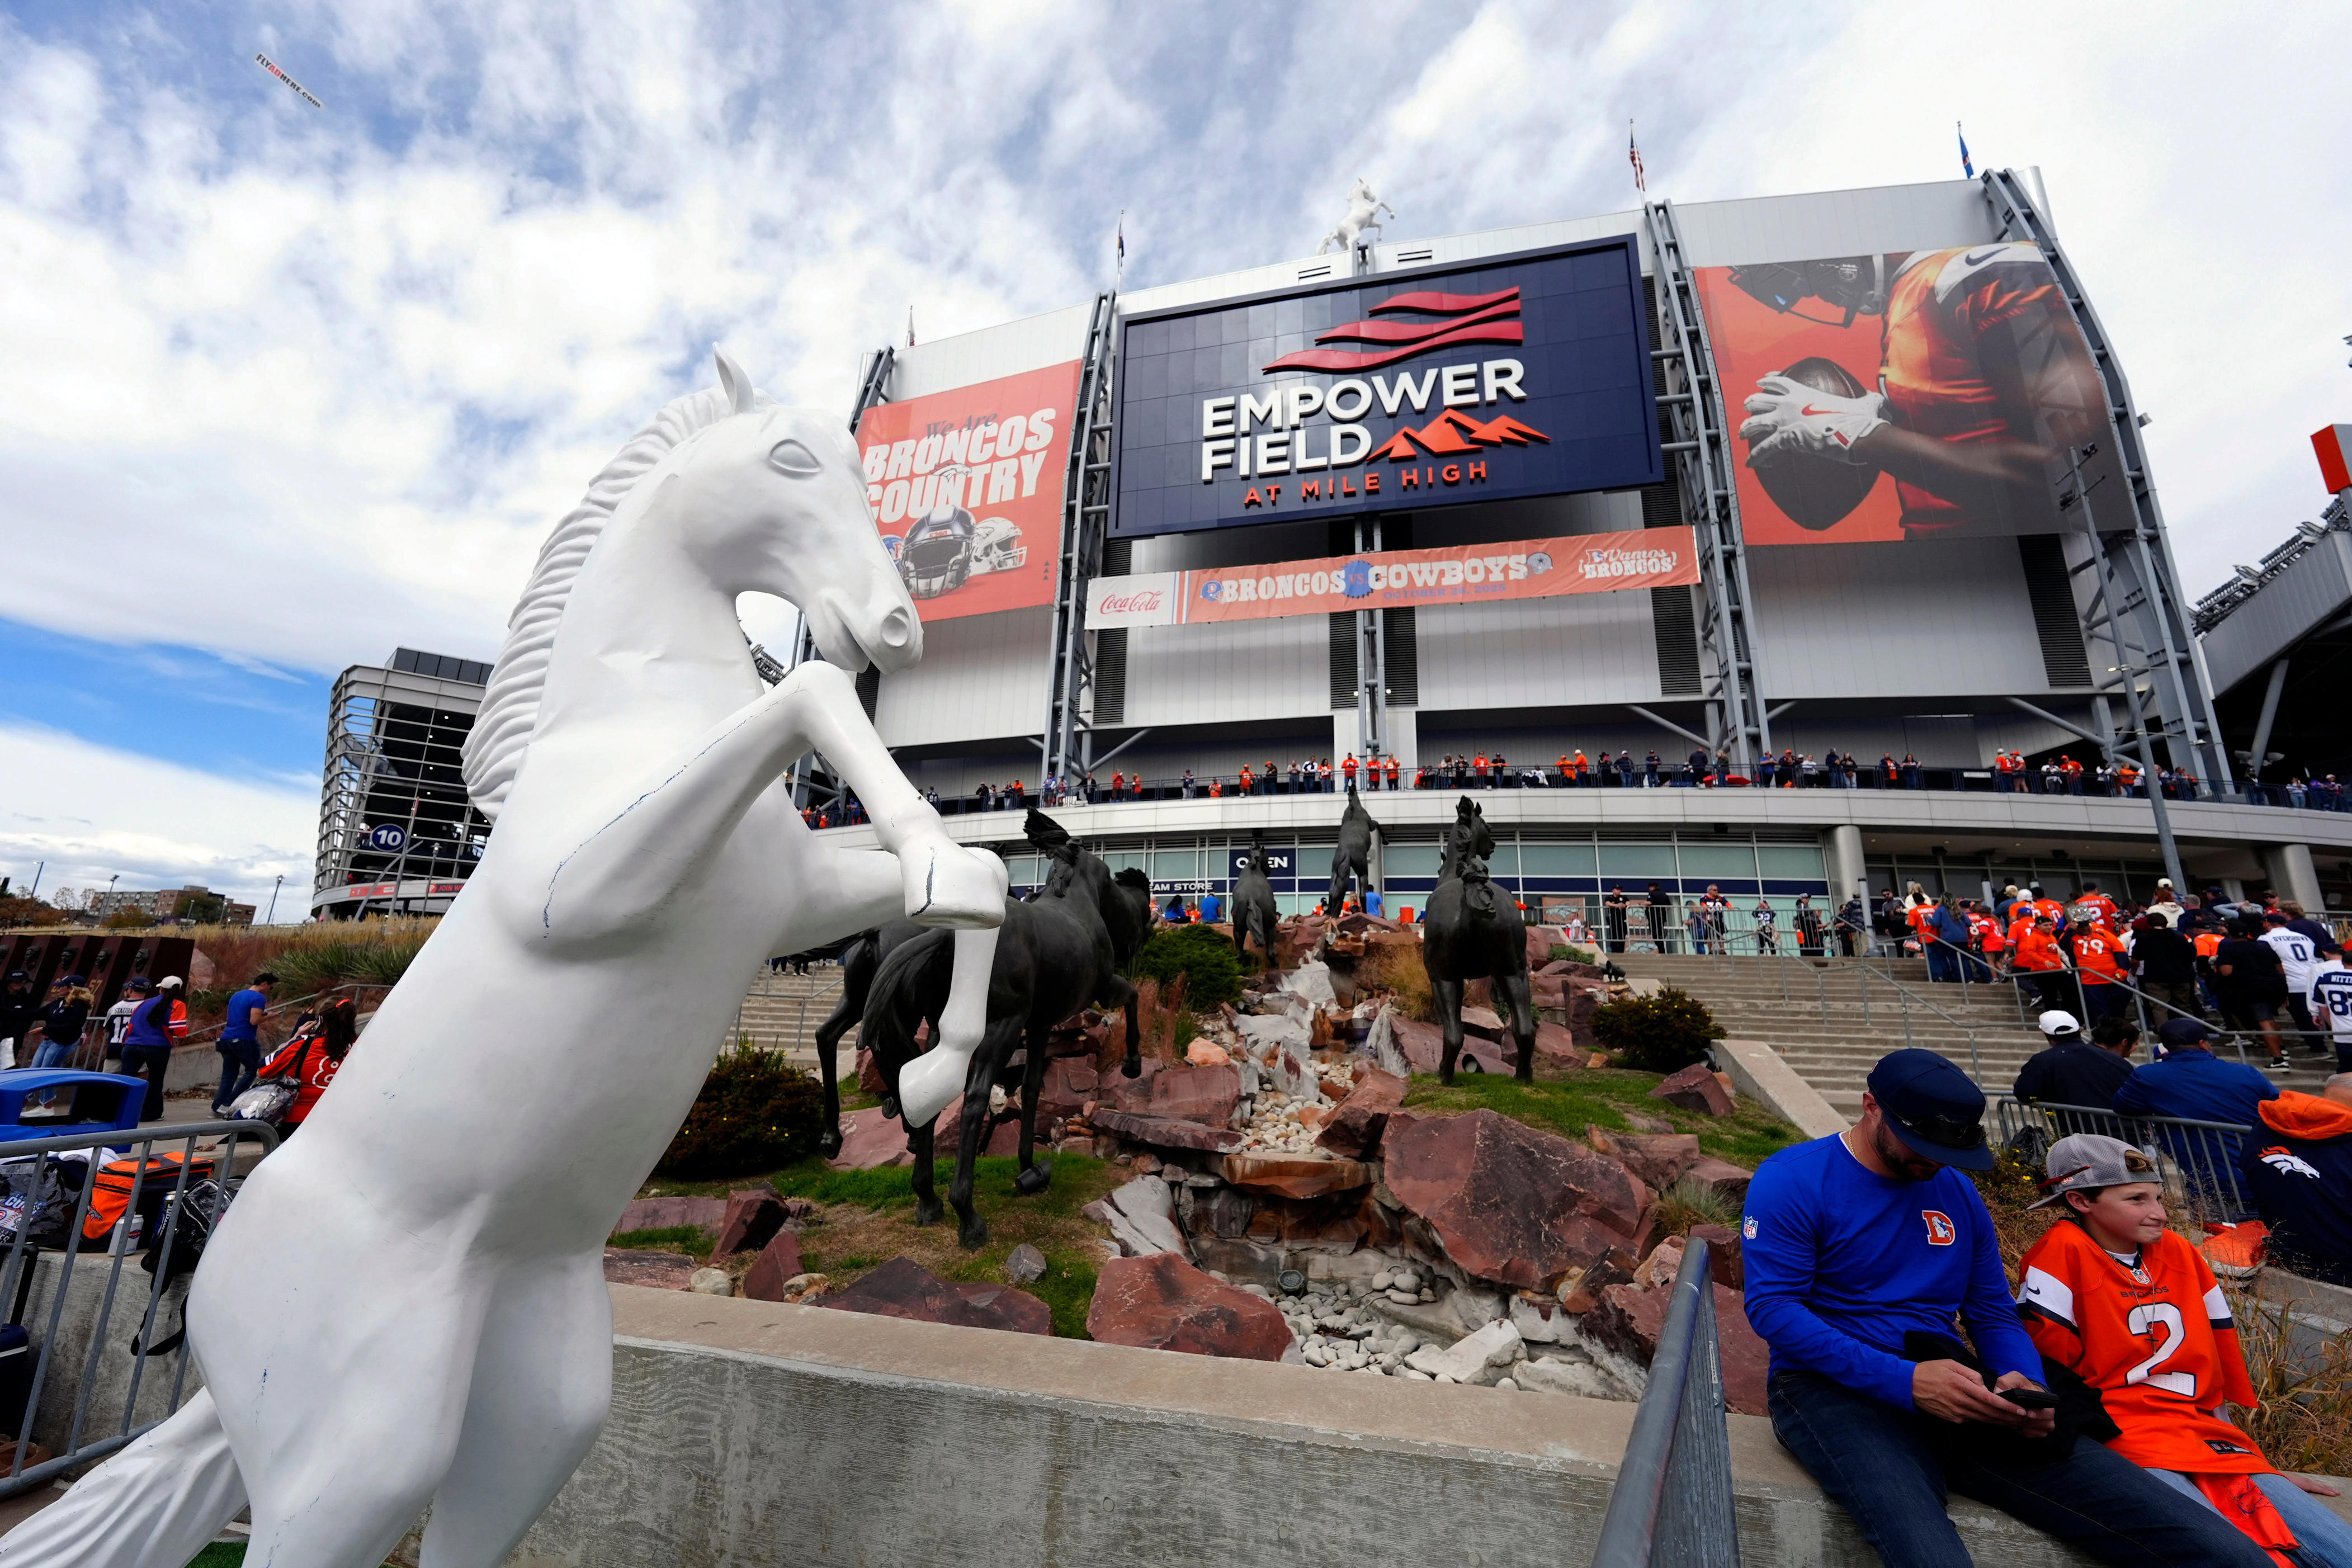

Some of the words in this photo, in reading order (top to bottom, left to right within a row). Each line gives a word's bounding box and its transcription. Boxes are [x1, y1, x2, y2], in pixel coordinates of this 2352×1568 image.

[1202, 358, 1527, 438] EMPOWER
[925, 421, 955, 439] We
[961, 412, 998, 433] Are
[862, 408, 1056, 483] BRONCOS
[1202, 423, 1373, 483] FIELD
[1244, 484, 1281, 508] AT
[1301, 472, 1380, 500] MILE
[1401, 460, 1489, 489] HIGH
[1221, 569, 1347, 603] BRONCOS
[1368, 554, 1528, 591] COWBOYS
[1383, 588, 1447, 600] OCTOBER
[1474, 583, 1506, 594] 2025
[1100, 590, 1164, 615] Coca-Cola
[377, 829, 402, 847] 10
[1236, 856, 1288, 868] OEN
[1149, 882, 1170, 892] EAM
[1174, 882, 1213, 891] STORE
[2077, 939, 2104, 955] 79
[2290, 943, 2308, 962] 0
[2125, 1301, 2197, 1397] 2
